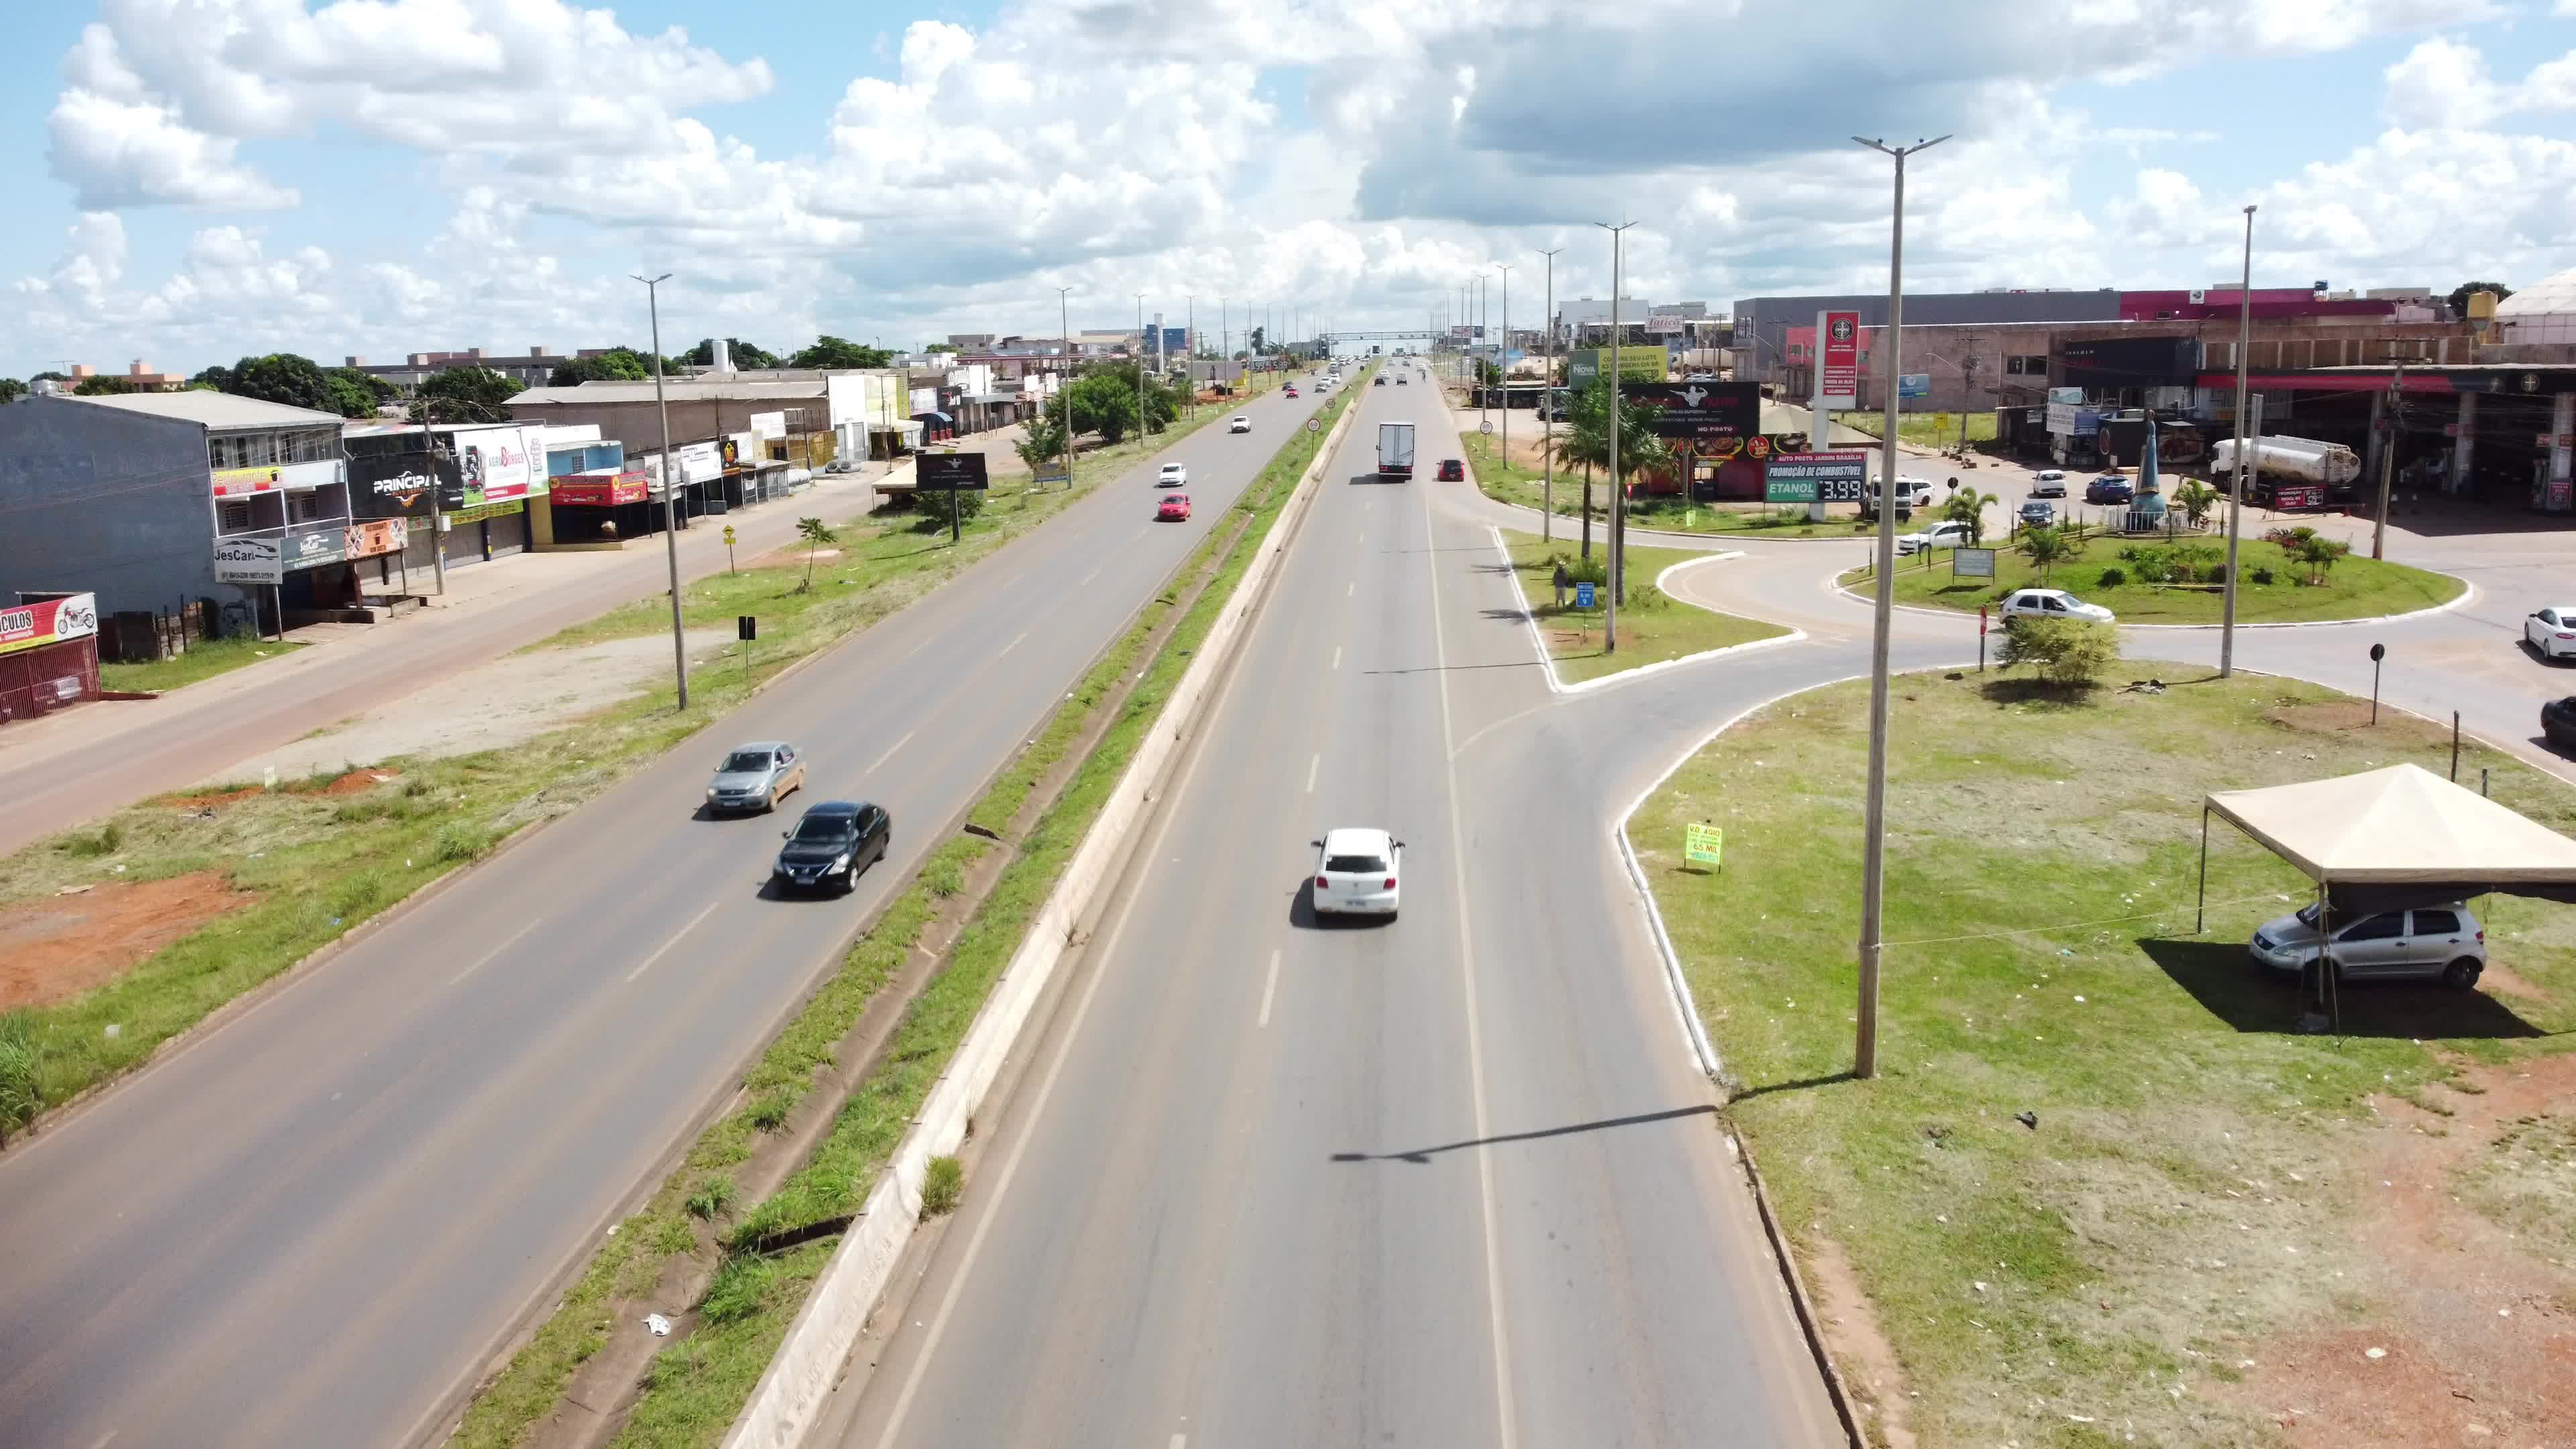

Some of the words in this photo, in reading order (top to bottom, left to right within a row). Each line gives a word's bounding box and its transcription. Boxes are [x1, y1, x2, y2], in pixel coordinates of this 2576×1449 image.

[1769, 466, 1806, 478] PROMOÇÃO
[1806, 469, 1815, 477] DE
[1815, 464, 1861, 477] COMBUSTÍVEL
[1769, 483, 1815, 493] ETANOL
[214, 549, 253, 561] JesCar
[0, 611, 32, 632] CULOS
